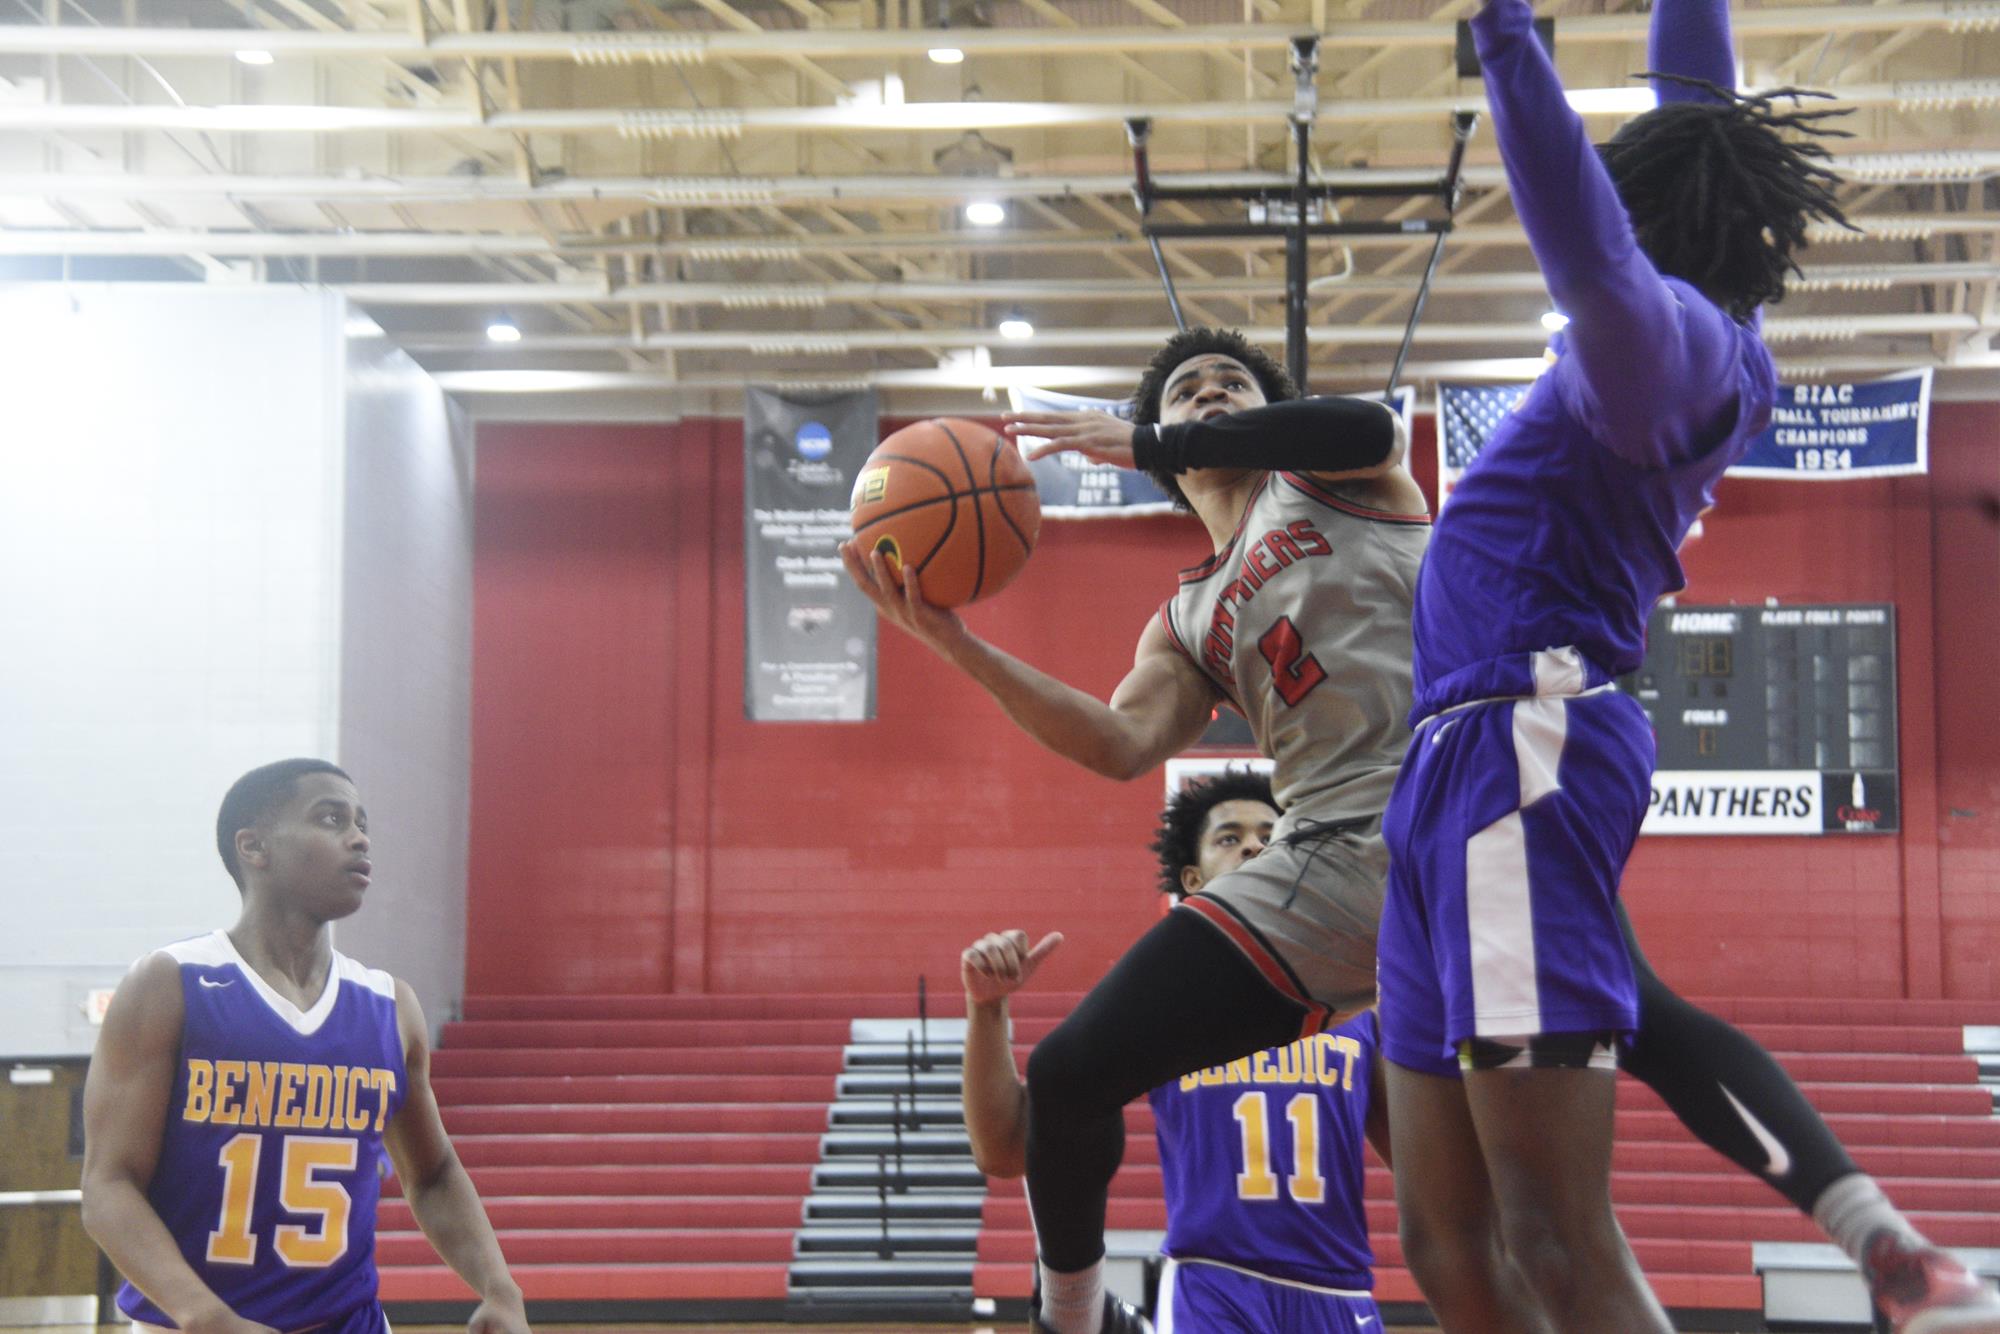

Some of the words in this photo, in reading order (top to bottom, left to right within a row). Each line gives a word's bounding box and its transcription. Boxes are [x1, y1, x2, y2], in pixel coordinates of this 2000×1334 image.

[1794, 384, 1854, 404] SIAC
[1820, 401, 1921, 424] TOURNAMENT
[1775, 427, 1869, 446] CHAMPIONS
[1795, 448, 1852, 470] 1954
[1204, 518, 1334, 686] ANTHERS
[1671, 612, 1737, 633] HOME
[1761, 610, 1802, 625] PLAYER
[1258, 615, 1328, 708] 2
[1683, 709, 1728, 725] FOULS
[183, 1058, 397, 1133] BENEDICT
[1233, 1091, 1327, 1205] 11
[206, 1133, 359, 1269] 15
